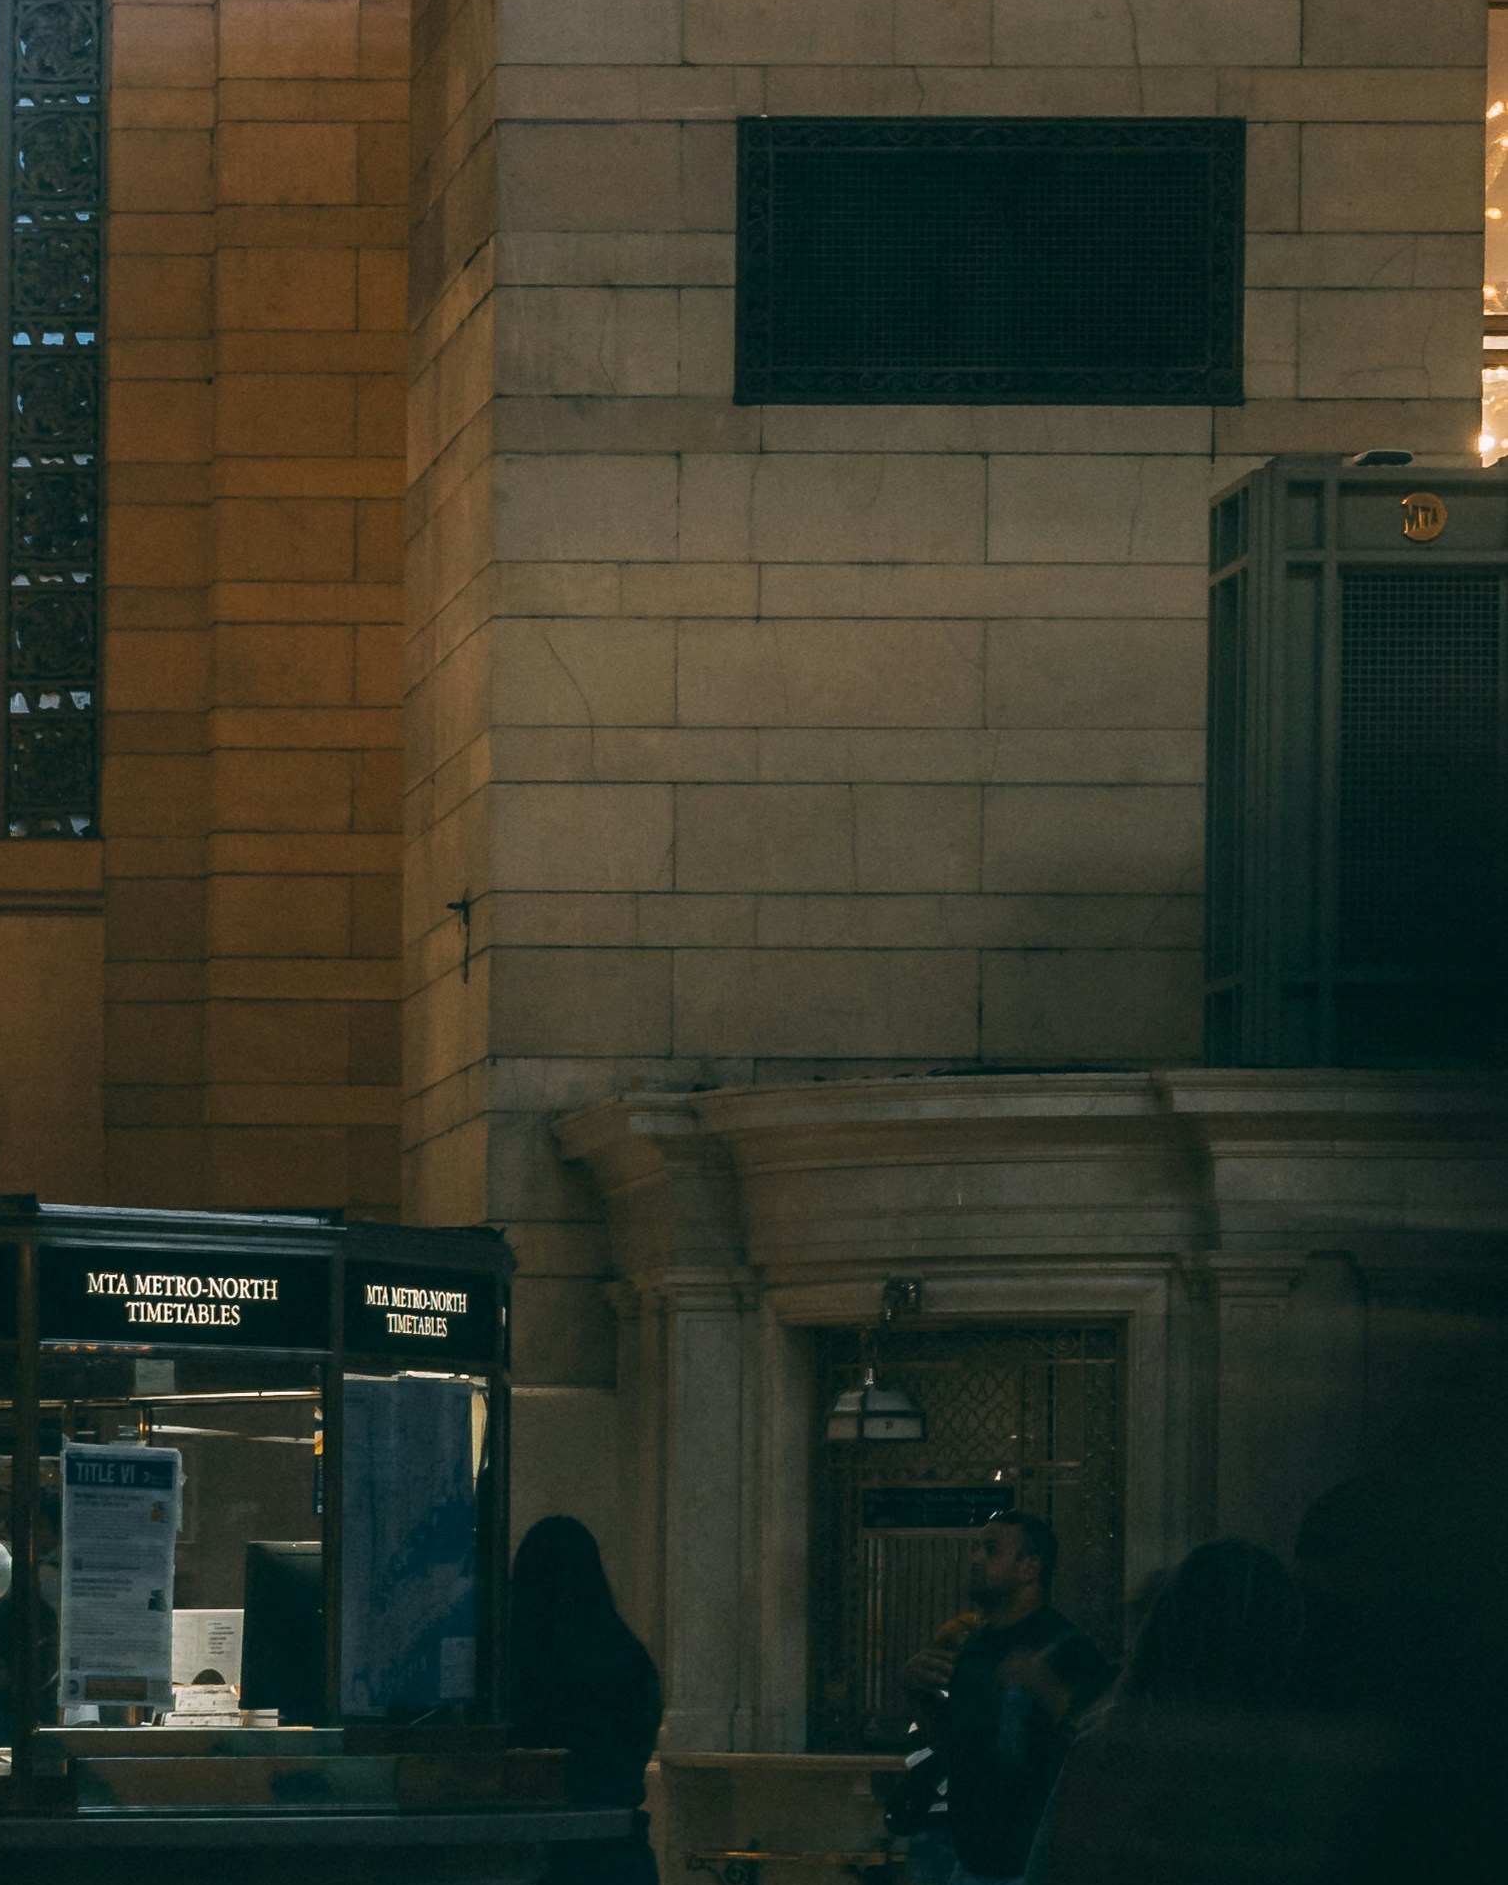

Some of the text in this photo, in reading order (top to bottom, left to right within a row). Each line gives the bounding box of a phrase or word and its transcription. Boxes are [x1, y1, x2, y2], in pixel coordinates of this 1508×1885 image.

[87, 1272, 279, 1301] MTA METRO-NORTH
[364, 1284, 468, 1313] MTA METRO-NORTH
[125, 1301, 241, 1326] TIMETABLES
[386, 1312, 448, 1337] TIMETABLES
[76, 1462, 116, 1483] TITLE
[120, 1464, 135, 1484] VI
